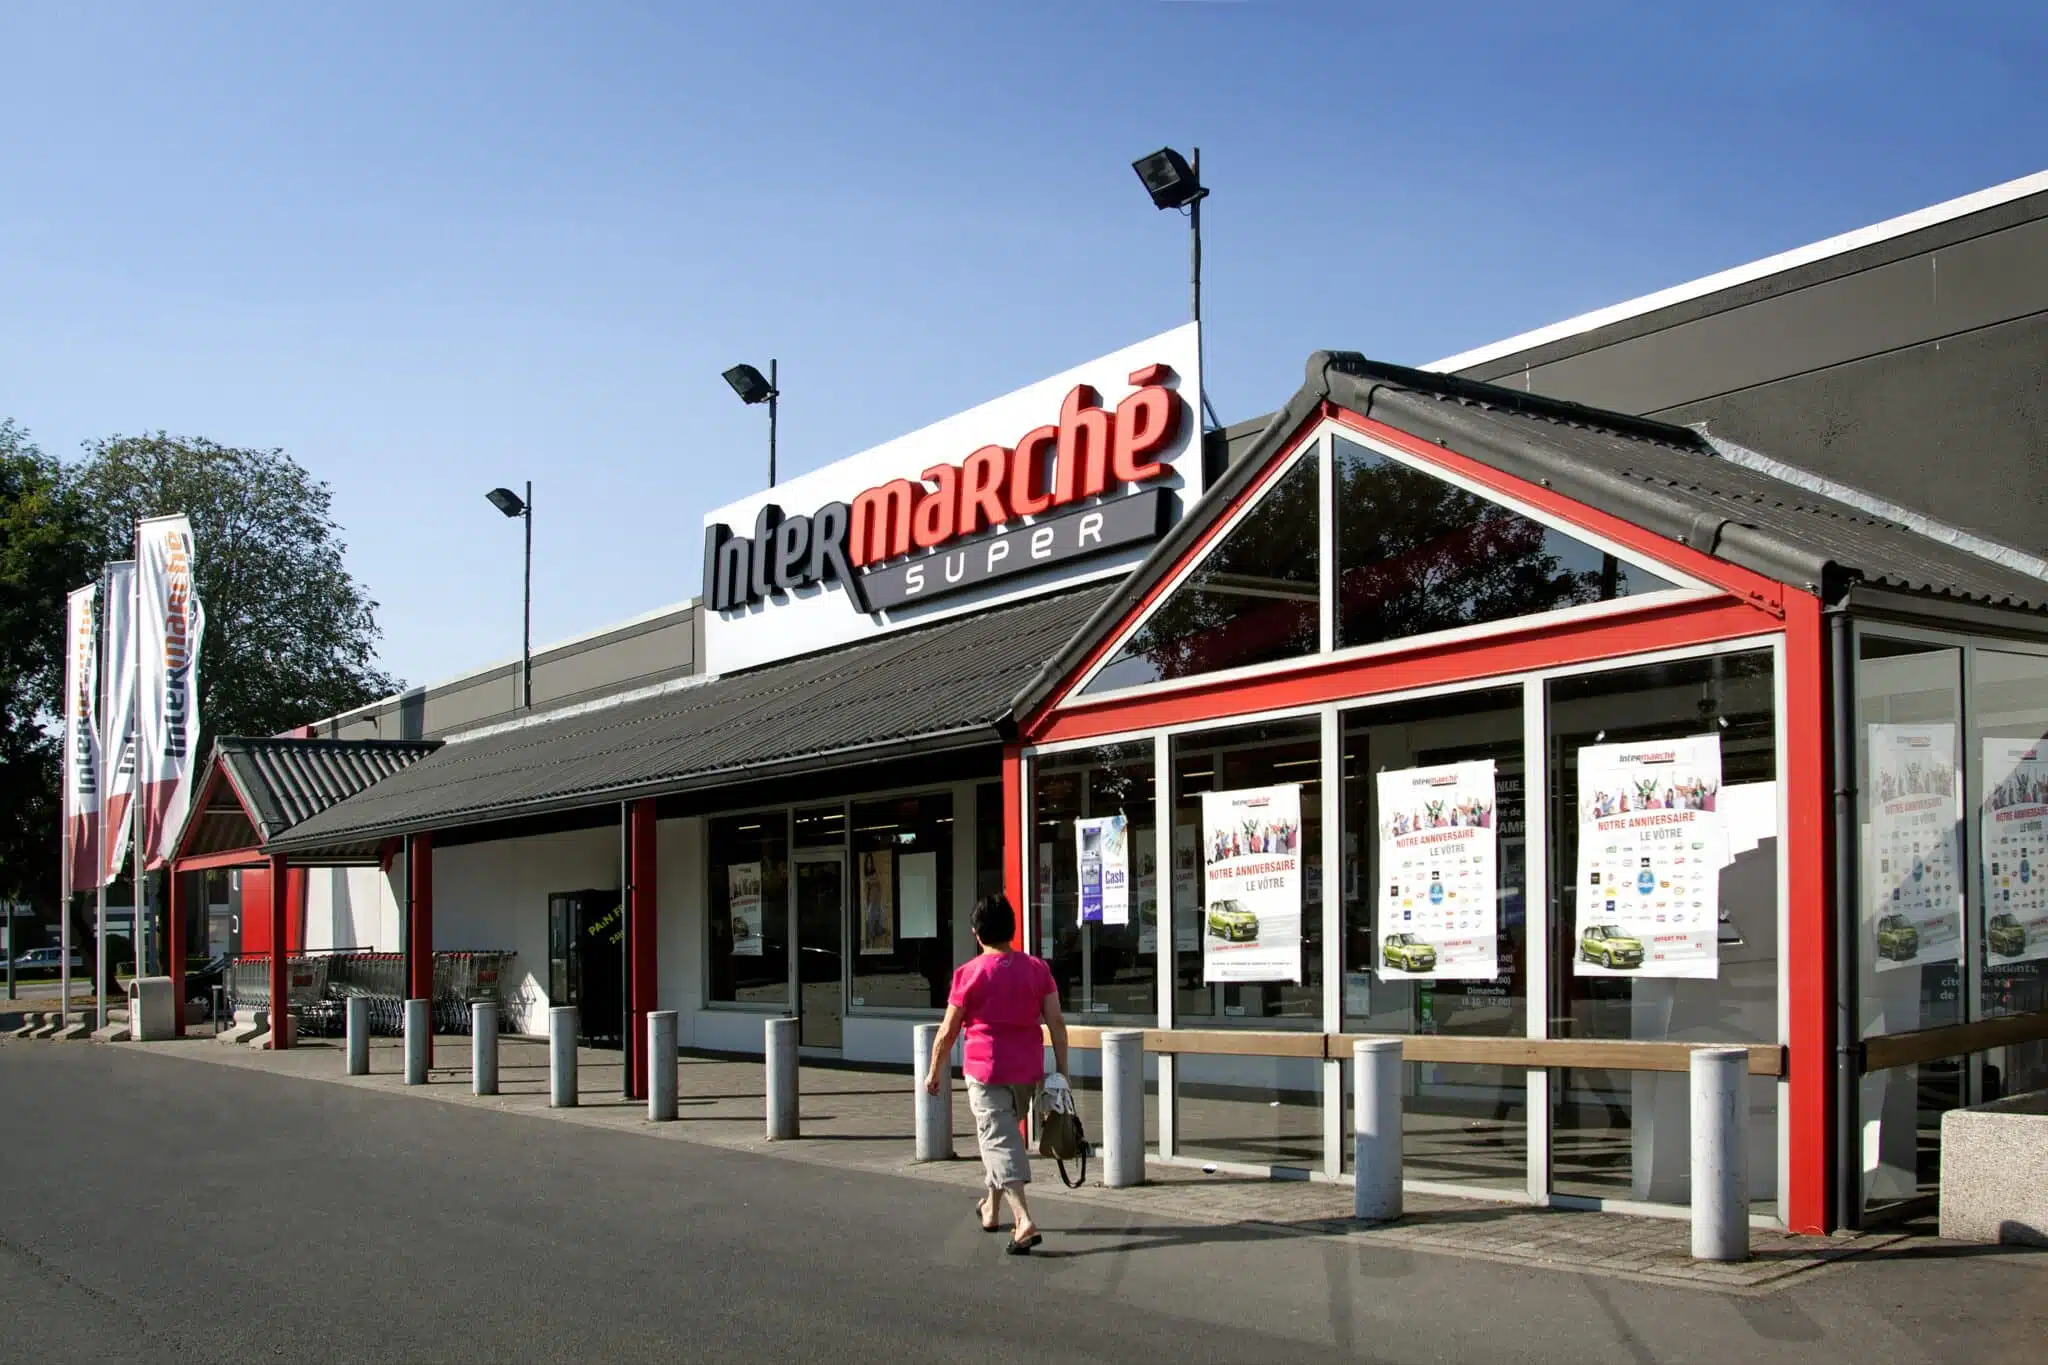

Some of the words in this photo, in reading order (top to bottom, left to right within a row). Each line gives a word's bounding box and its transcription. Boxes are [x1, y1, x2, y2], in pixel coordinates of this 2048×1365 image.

[1598, 818, 1626, 831] NOTRE
[1629, 811, 1696, 828] ANNIVERSAIRE
[1396, 837, 1418, 848] NOTRE
[1420, 828, 1475, 845] ANNIVERSAIRE
[1640, 831, 1652, 841] LE
[1430, 847, 1439, 856] LE
[1105, 868, 1124, 885] Cash
[1209, 867, 1233, 880] NOTRE
[1236, 859, 1295, 876] ANNIVERSAIRE
[1245, 880, 1256, 891] LE
